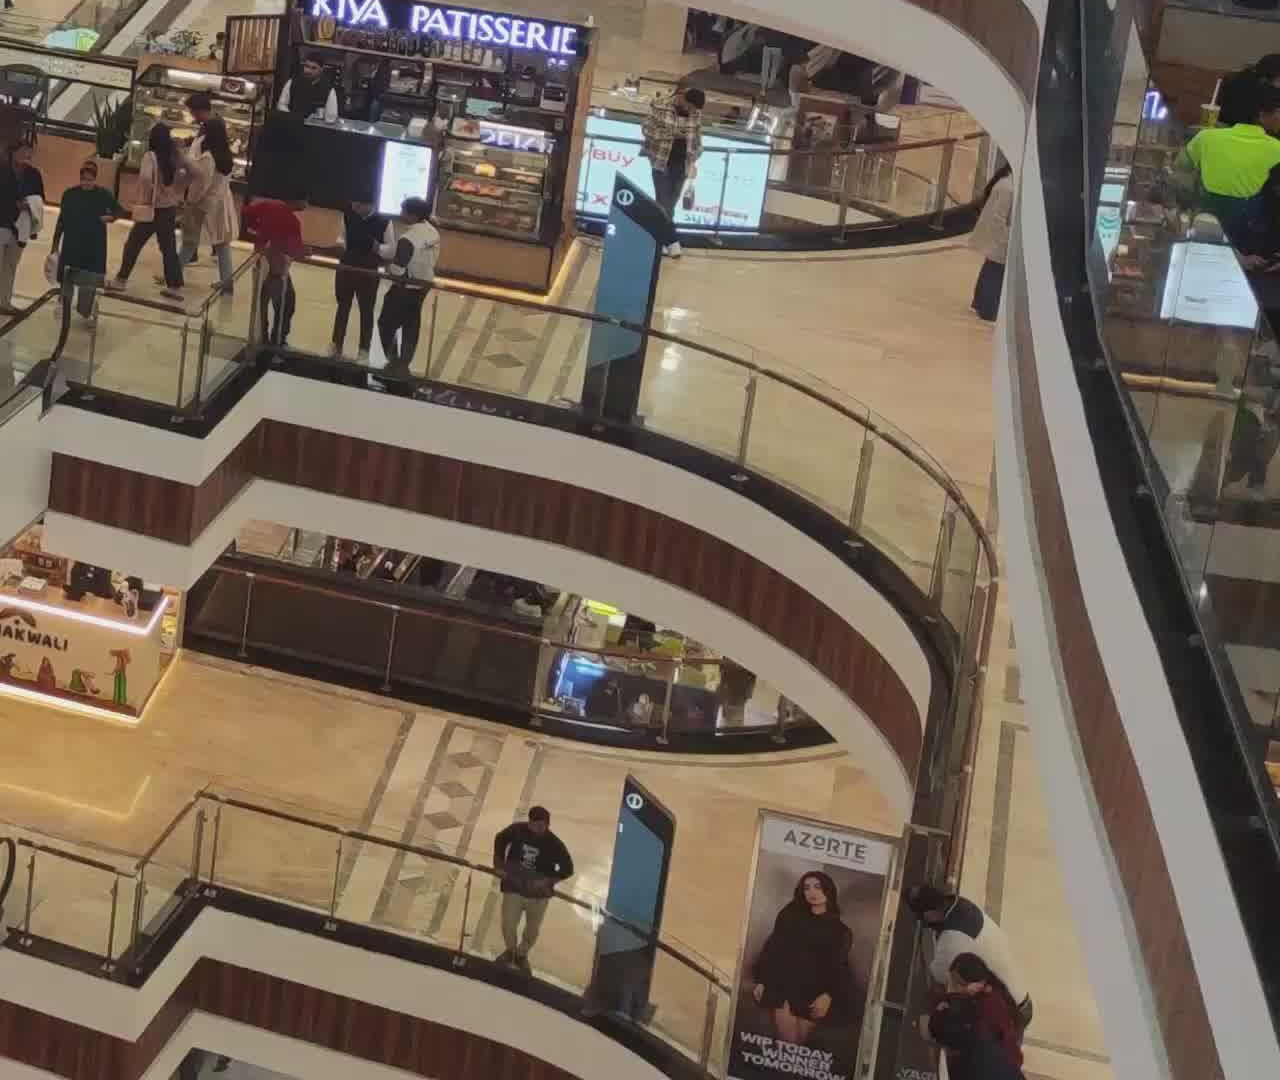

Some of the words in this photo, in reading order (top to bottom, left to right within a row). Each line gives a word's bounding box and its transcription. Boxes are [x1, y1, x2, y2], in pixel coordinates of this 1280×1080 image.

[411, 5, 577, 55] PATISSERIE
[784, 828, 868, 862] AZORTE
[742, 1052, 847, 1080] TOMORROW
[762, 1047, 832, 1070] WINNER
